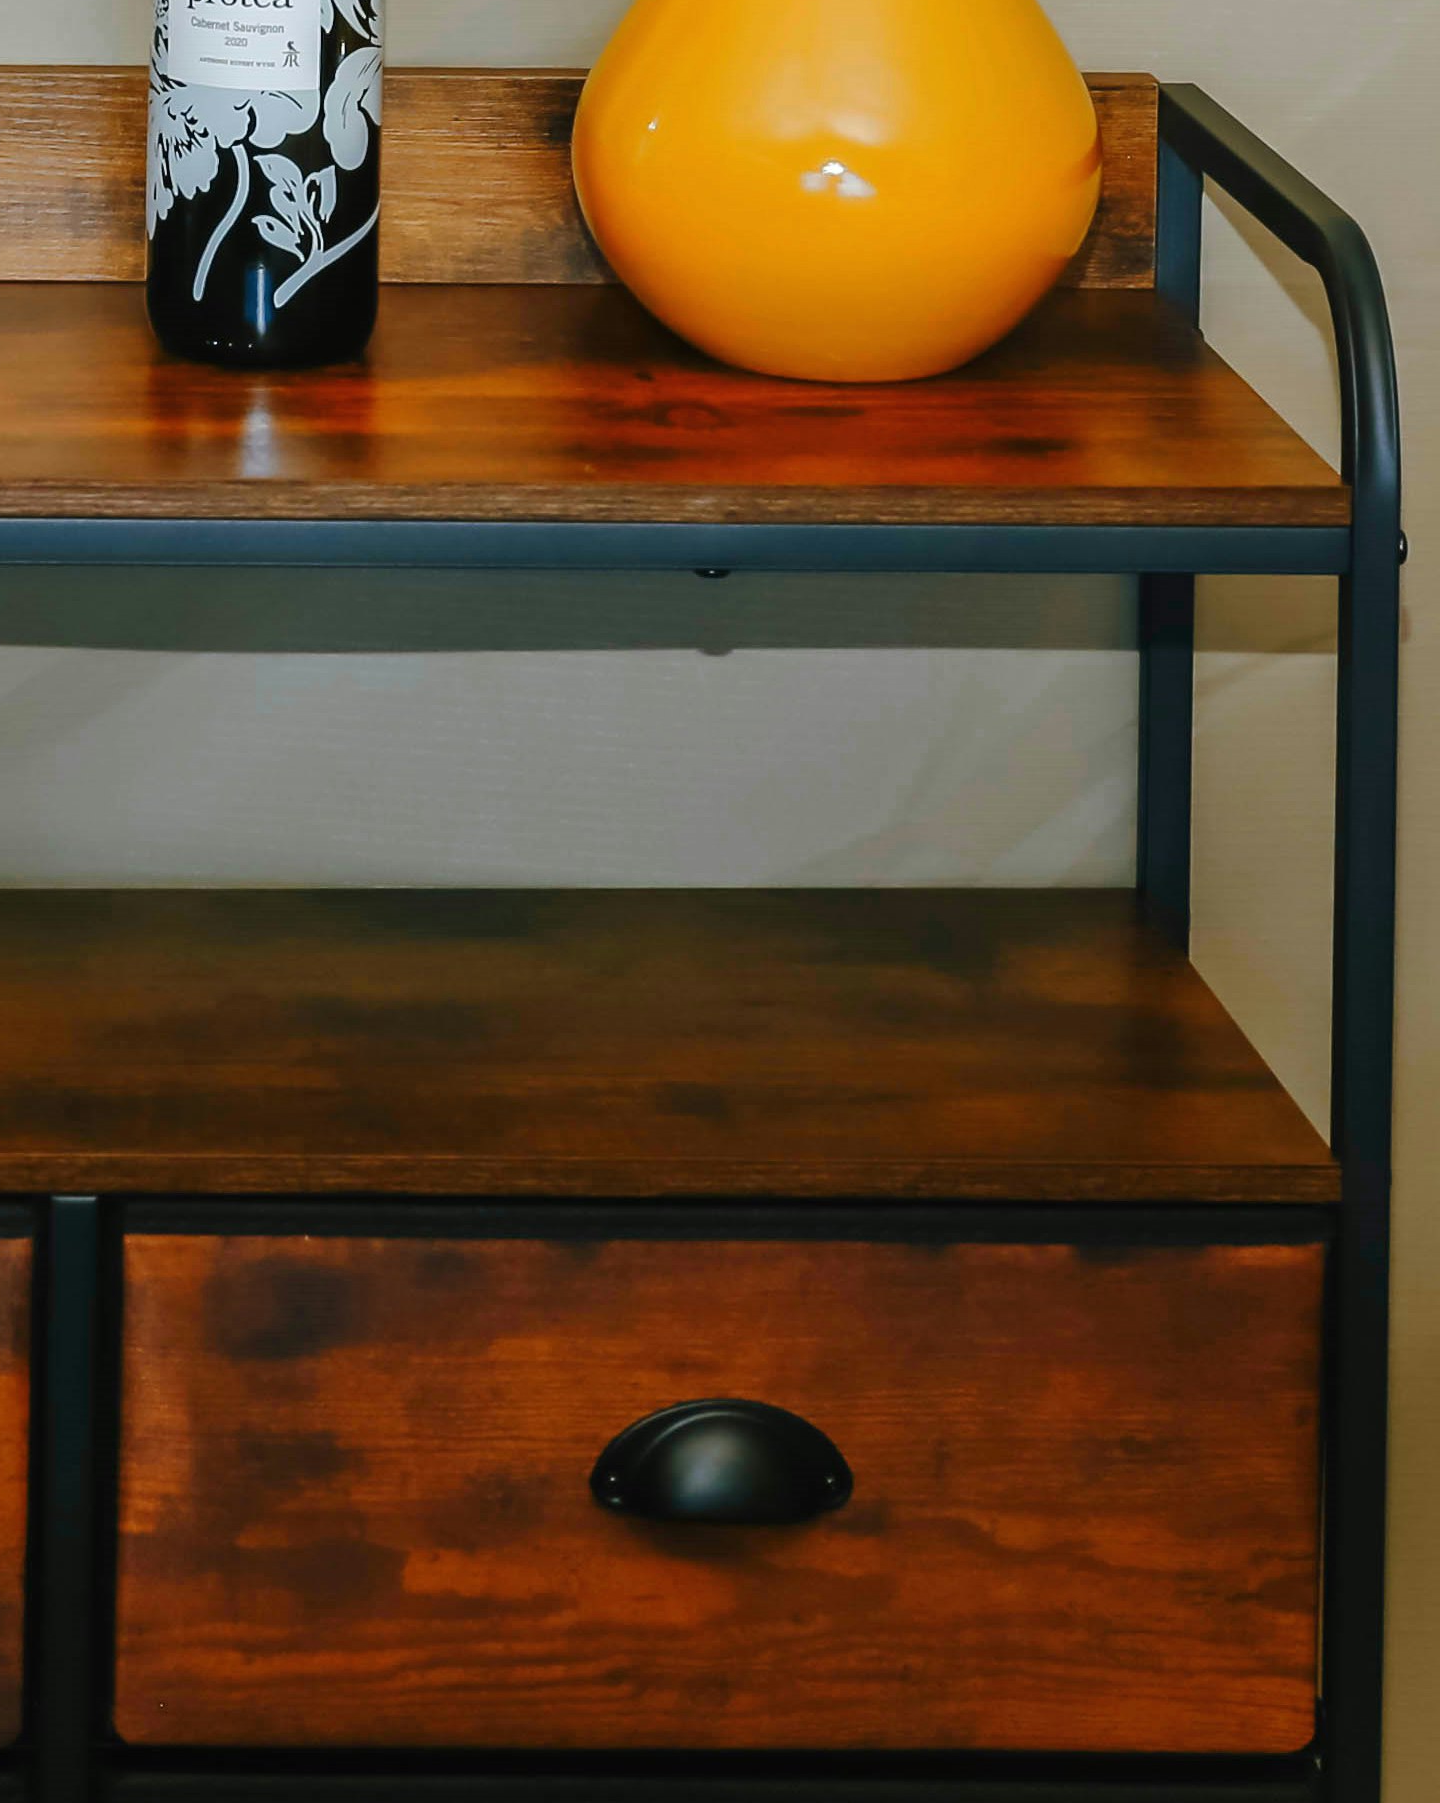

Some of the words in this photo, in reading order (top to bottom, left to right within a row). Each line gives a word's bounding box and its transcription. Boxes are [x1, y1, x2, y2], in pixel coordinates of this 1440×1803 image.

[190, 16, 230, 31] Cabernet
[233, 21, 285, 36] Sauvignon
[224, 36, 248, 47] 2020
